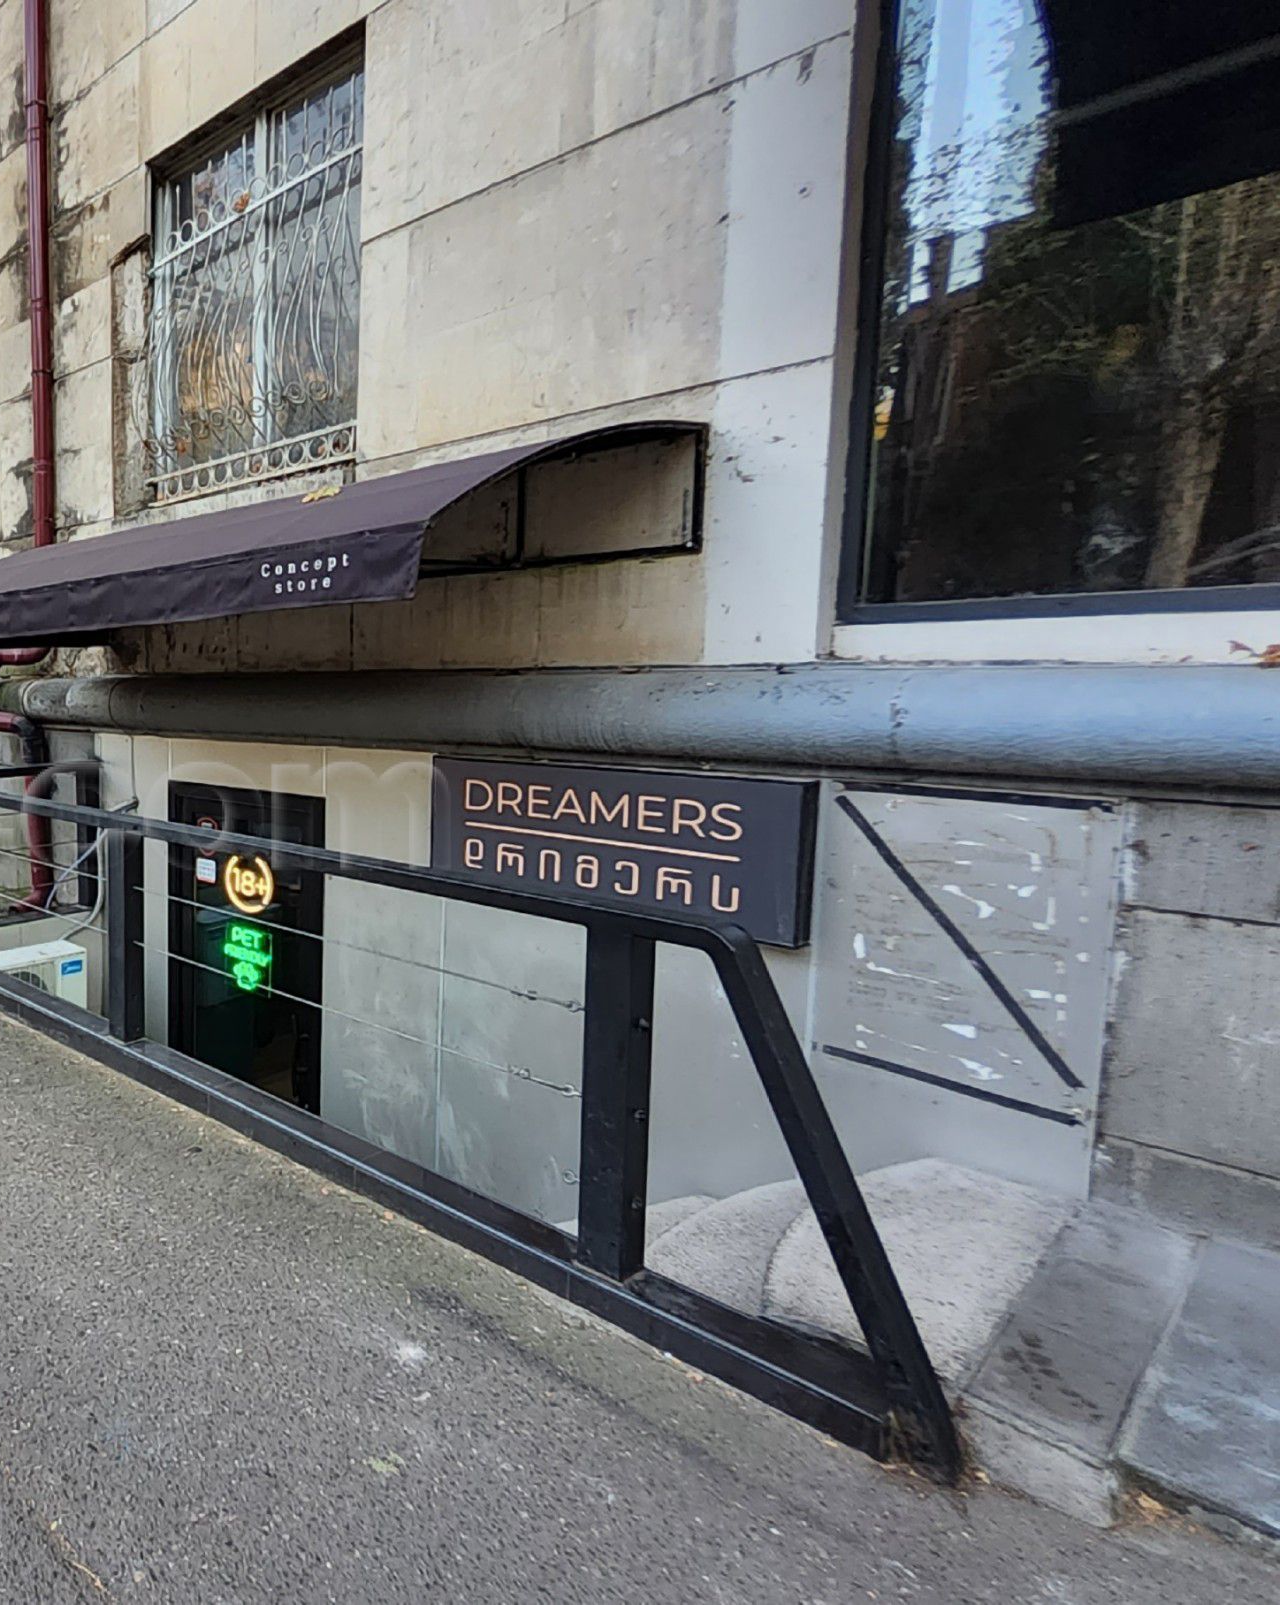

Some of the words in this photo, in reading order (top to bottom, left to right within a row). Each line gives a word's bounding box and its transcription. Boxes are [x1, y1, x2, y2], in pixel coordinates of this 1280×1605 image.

[260, 553, 350, 578] Concept
[274, 576, 332, 594] store
[463, 778, 744, 842] DREAMERS
[232, 867, 267, 897] 18+
[463, 837, 741, 913] დრიმერს
[231, 926, 263, 949] PET
